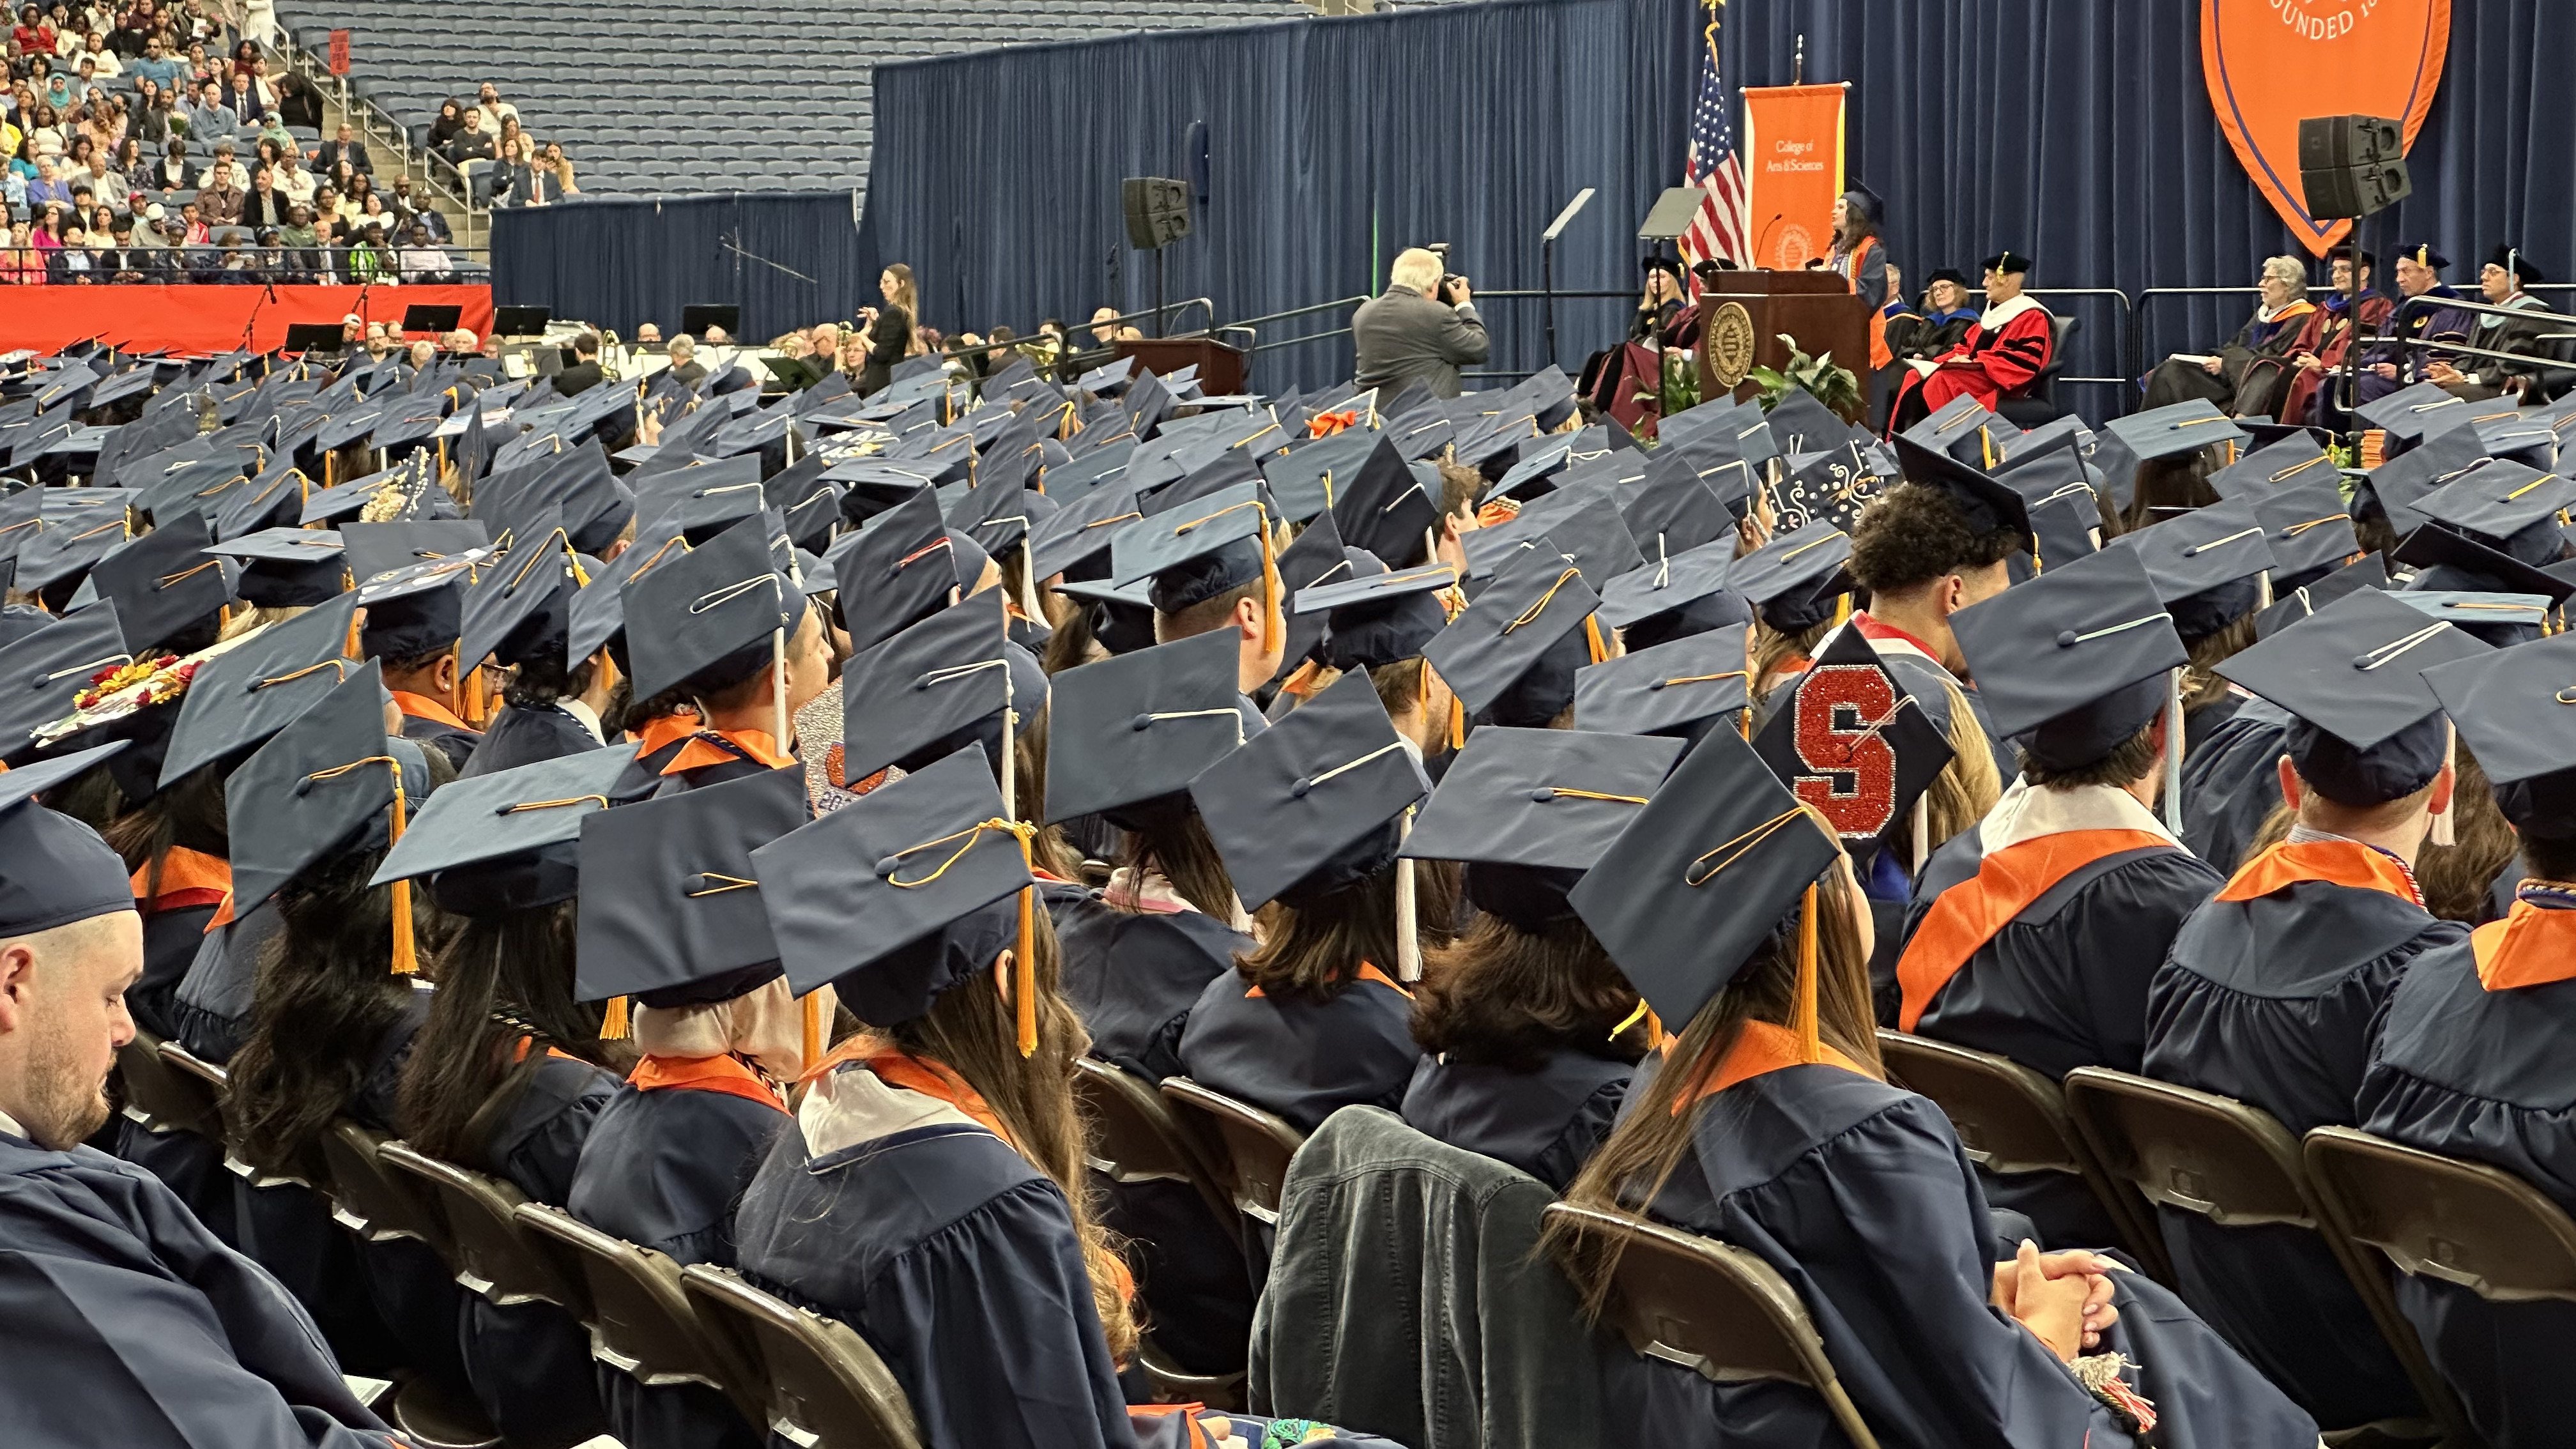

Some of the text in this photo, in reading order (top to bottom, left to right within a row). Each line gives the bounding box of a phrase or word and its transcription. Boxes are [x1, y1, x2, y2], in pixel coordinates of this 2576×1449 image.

[1776, 139, 1805, 155] College
[1766, 159, 1782, 172] Arts
[1791, 158, 1824, 171] Sciences
[1793, 664, 1896, 839] S
